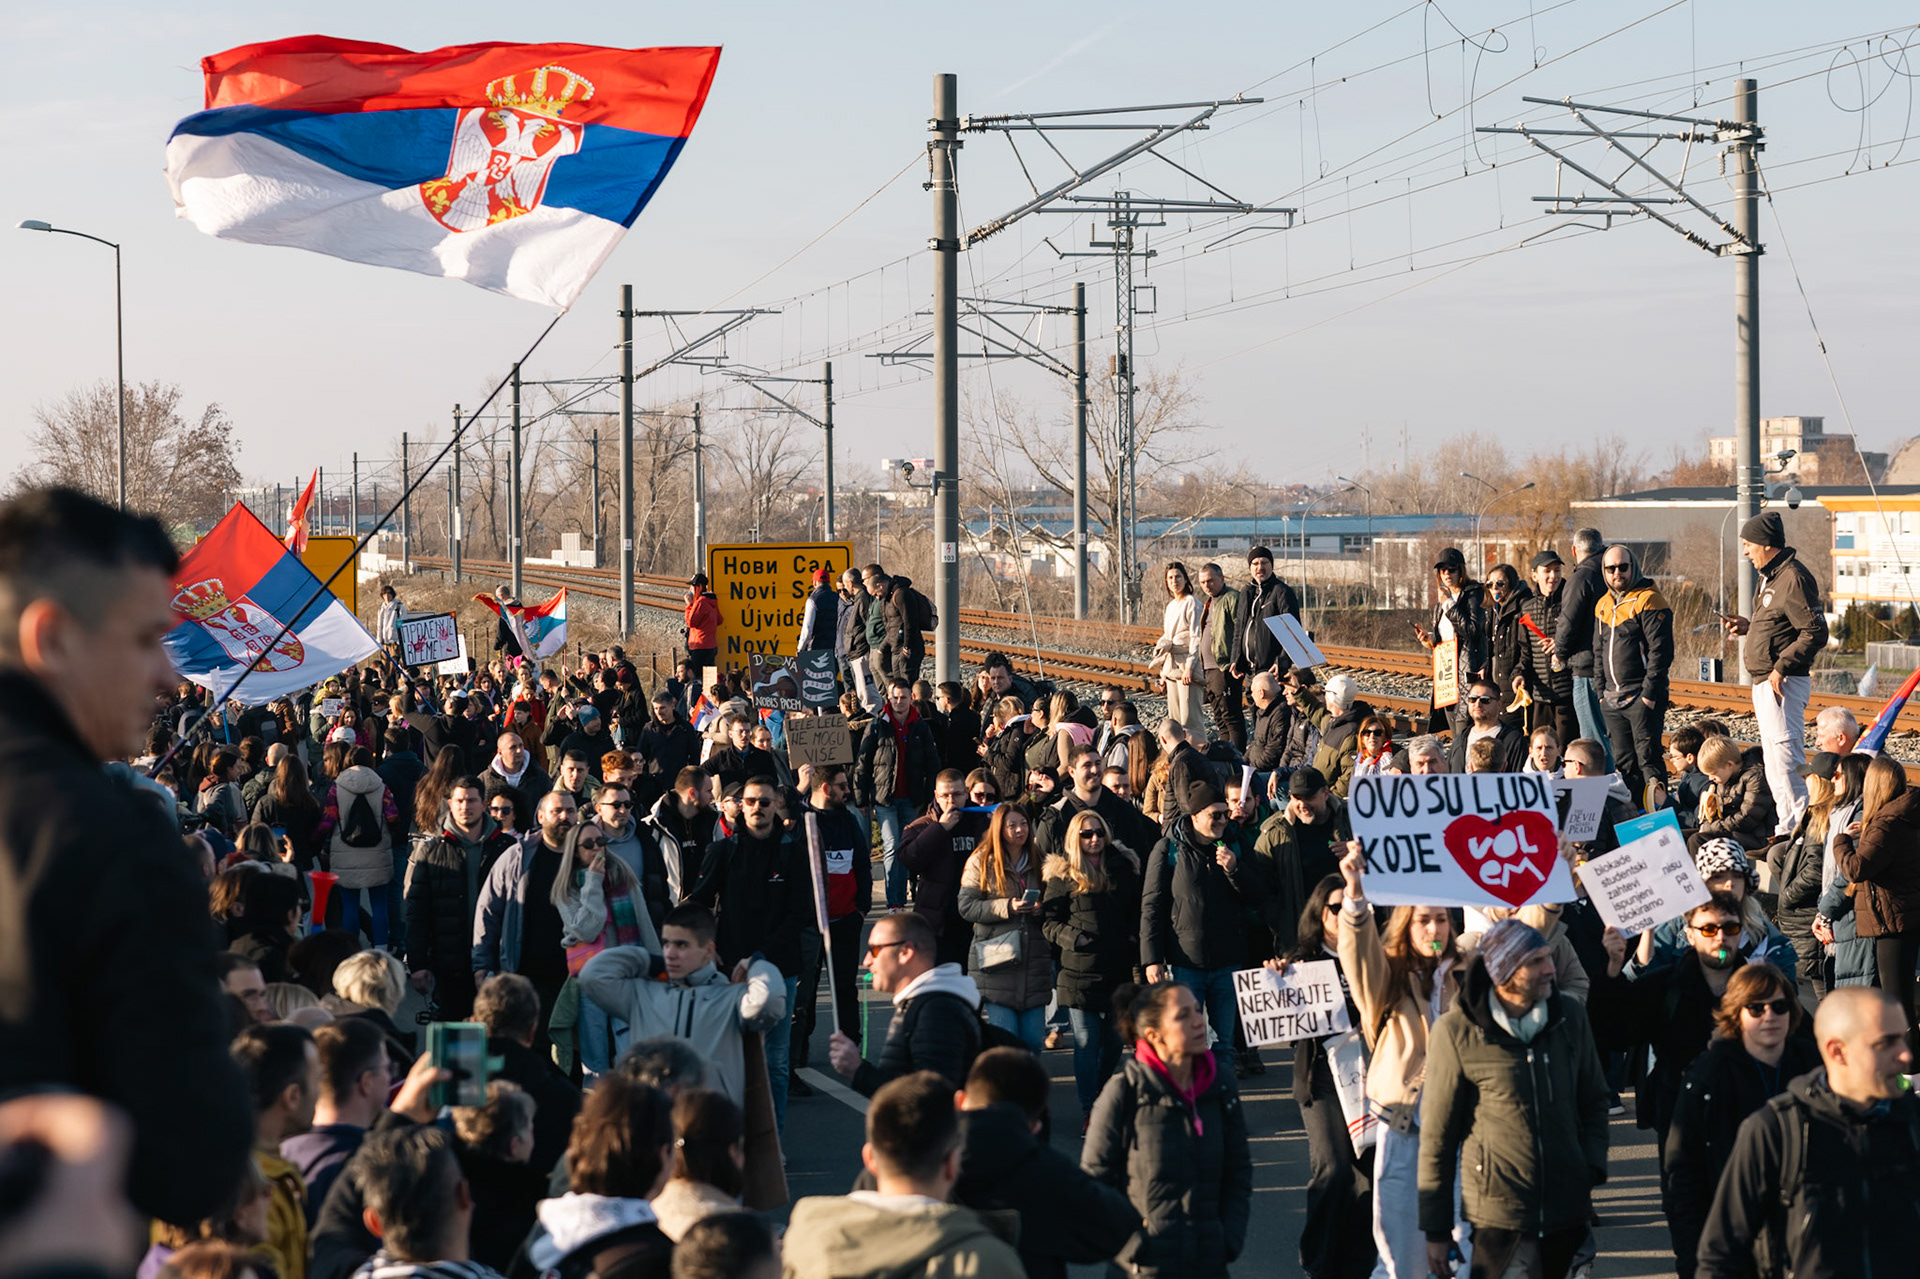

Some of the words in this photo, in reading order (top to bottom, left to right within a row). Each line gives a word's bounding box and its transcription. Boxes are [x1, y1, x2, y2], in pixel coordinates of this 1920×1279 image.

[724, 556, 777, 575] Нови
[793, 555, 835, 574] Сад
[730, 581, 776, 600] Novi
[792, 580, 815, 599] Sa
[741, 603, 805, 632] Újvidé
[728, 634, 780, 655] Nový
[755, 696, 779, 709] NOBIS
[788, 718, 815, 732] LELE
[817, 716, 844, 729] LELE
[791, 731, 808, 746] NE
[812, 730, 845, 746] MOGU
[804, 747, 837, 762] VISE
[1354, 777, 1419, 818] OVO
[1425, 776, 1463, 816] SU
[1569, 812, 1596, 823] DEVIL
[826, 851, 844, 860] ILA
[1360, 833, 1442, 874] KOJE
[1593, 853, 1632, 876] blokade
[1658, 834, 1671, 847] ali
[1600, 860, 1648, 888] studentski
[1607, 879, 1641, 900] zahtevi
[1661, 860, 1682, 875] nisu
[1611, 888, 1655, 912] ispunjeni
[1675, 872, 1689, 885] pa
[1618, 897, 1665, 924] blokiramo
[1683, 884, 1695, 895] tri
[1625, 916, 1655, 935] mosta
[1237, 970, 1261, 993] NE
[1240, 983, 1333, 1015] NERVIRAJTE
